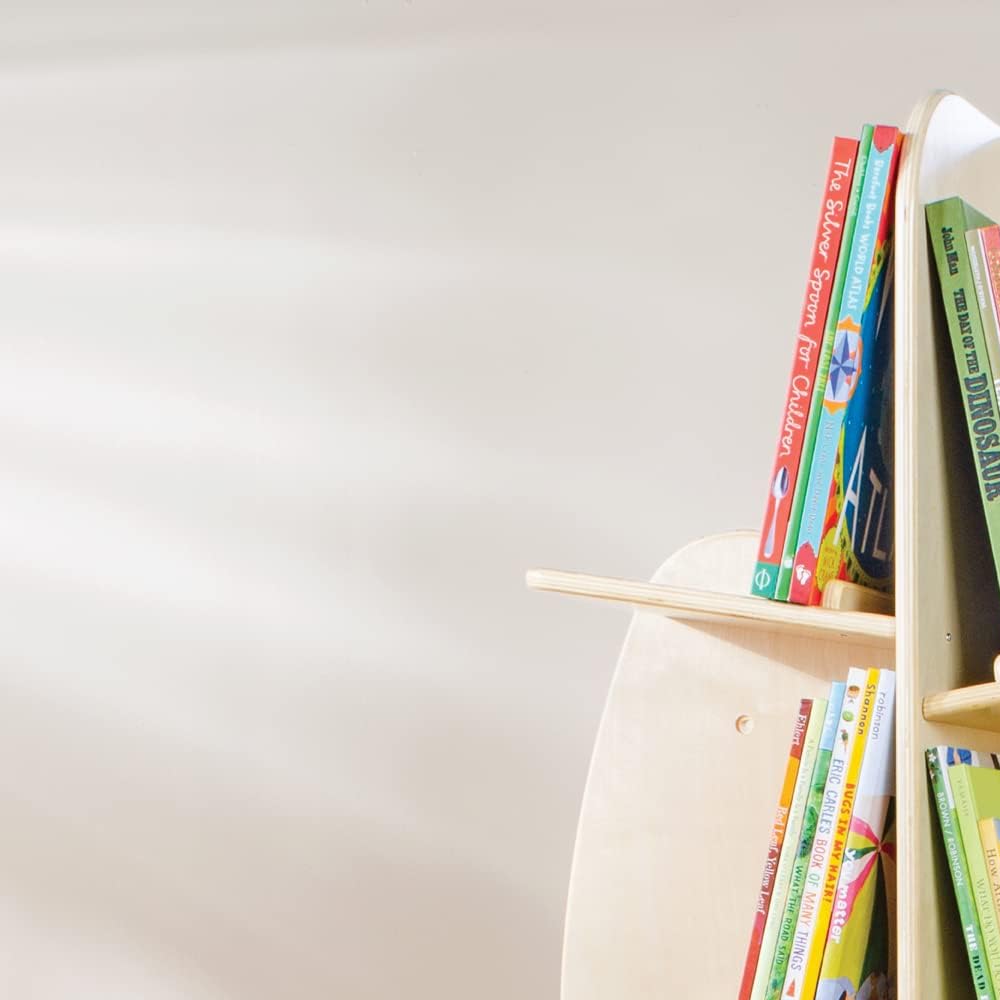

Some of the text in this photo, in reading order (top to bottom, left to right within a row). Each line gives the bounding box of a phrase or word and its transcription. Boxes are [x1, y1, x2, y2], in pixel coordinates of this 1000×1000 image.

[828, 156, 851, 194] The
[815, 198, 844, 263] Silver
[940, 226, 956, 251] John
[852, 232, 870, 275] WORLD
[945, 251, 961, 276] Man
[802, 267, 830, 329] Spoon
[846, 276, 862, 310] ATLAS
[951, 288, 968, 312] THE
[956, 312, 973, 335] DAY
[793, 333, 818, 369] for
[961, 335, 976, 351] OF
[964, 350, 980, 375] THE
[777, 373, 810, 458] Children
[833, 427, 893, 562] ATL
[856, 683, 875, 735] Shannon
[870, 691, 888, 740] robinson
[791, 713, 806, 745] Ehlert
[774, 806, 787, 826] Red
[821, 782, 855, 902] BUGS IN MY HAIR!
[936, 791, 951, 827] BROWN
[945, 837, 963, 886] ROBINSON
[761, 855, 776, 887] Yellow
[789, 758, 844, 971] ERIC CARLE'S BOOK OF MANY THINGS
[789, 864, 802, 893] WHAT
[986, 848, 1000, 877] How
[756, 890, 769, 914] Leaf
[785, 897, 796, 915] THE
[974, 878, 991, 915] WHAT
[780, 917, 792, 941] ROAD
[829, 884, 851, 943] matter
[982, 915, 995, 934] DO
[775, 942, 786, 965] SAID
[964, 923, 977, 951] THE
[971, 955, 986, 990] DEAD
[986, 935, 1000, 960] YOU
